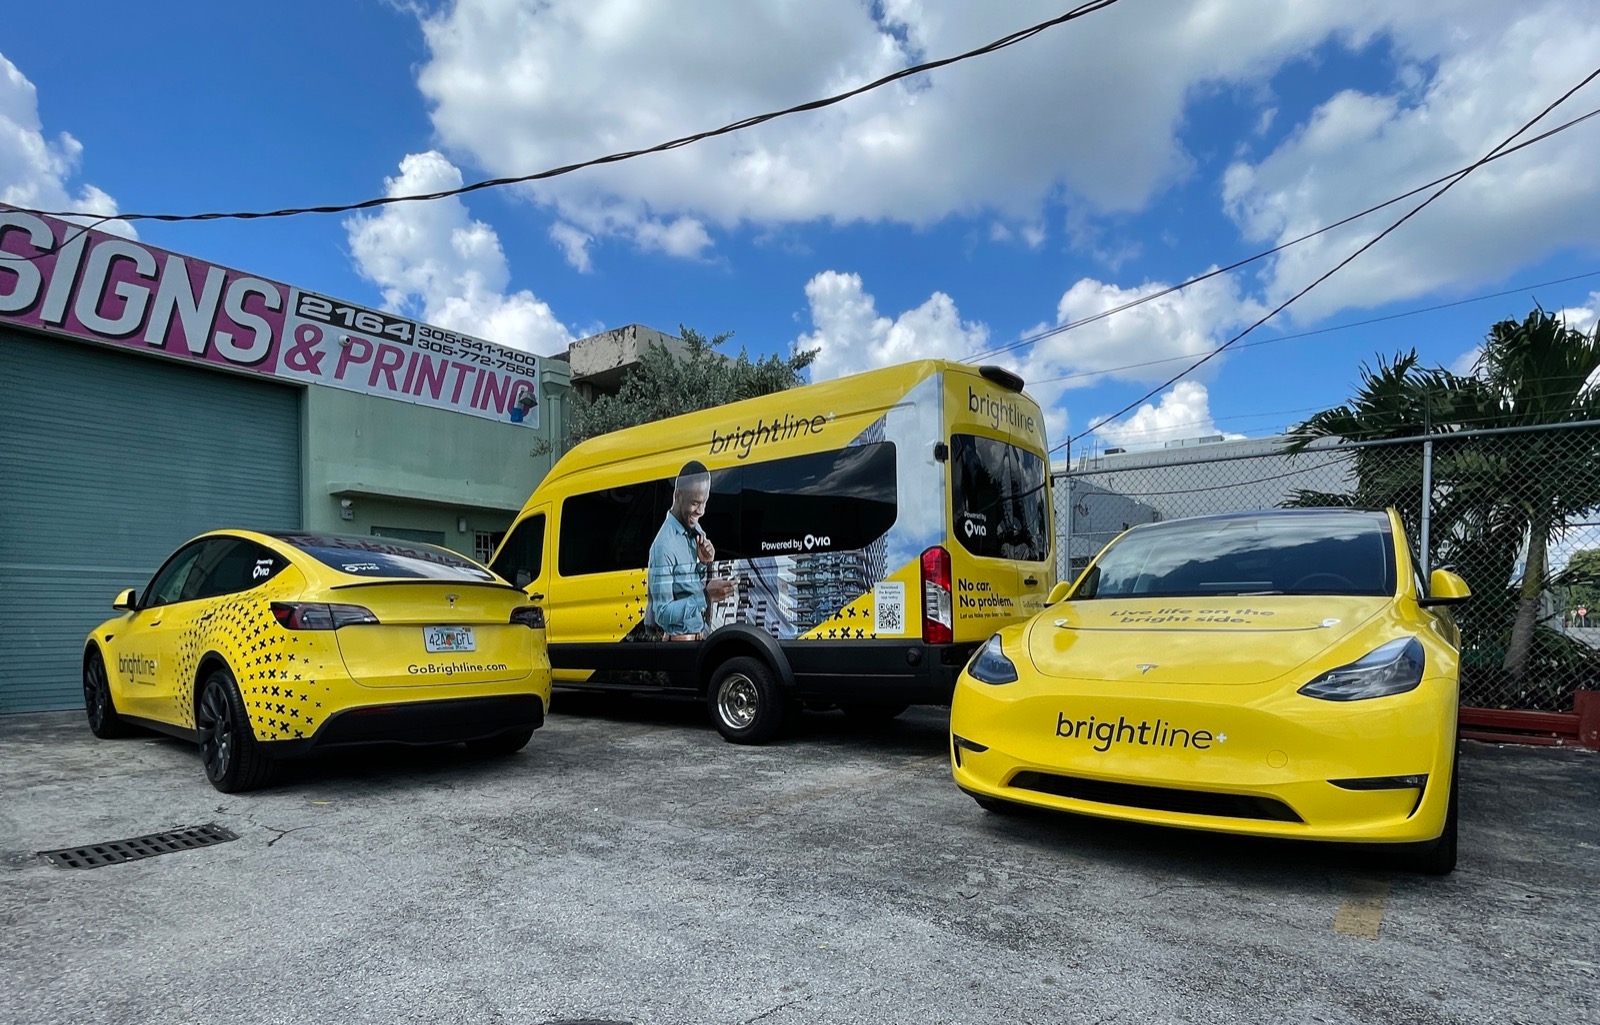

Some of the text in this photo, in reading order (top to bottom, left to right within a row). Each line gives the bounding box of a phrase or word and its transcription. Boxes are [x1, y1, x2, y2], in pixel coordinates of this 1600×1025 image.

[0, 212, 281, 363] SIGNS
[299, 297, 412, 342] 2164
[284, 323, 326, 375] &
[418, 326, 536, 366] 305-541-1400
[417, 338, 536, 378] 305-772-7558
[761, 539, 792, 551] Powered
[793, 539, 803, 551] by
[958, 578, 992, 592] No car.
[959, 594, 976, 608] No
[977, 593, 1014, 611] problem.
[1110, 609, 1152, 617] Live
[1235, 608, 1275, 617] the
[1120, 615, 1252, 624] bright side.
[407, 662, 507, 675] GoBrightline.com
